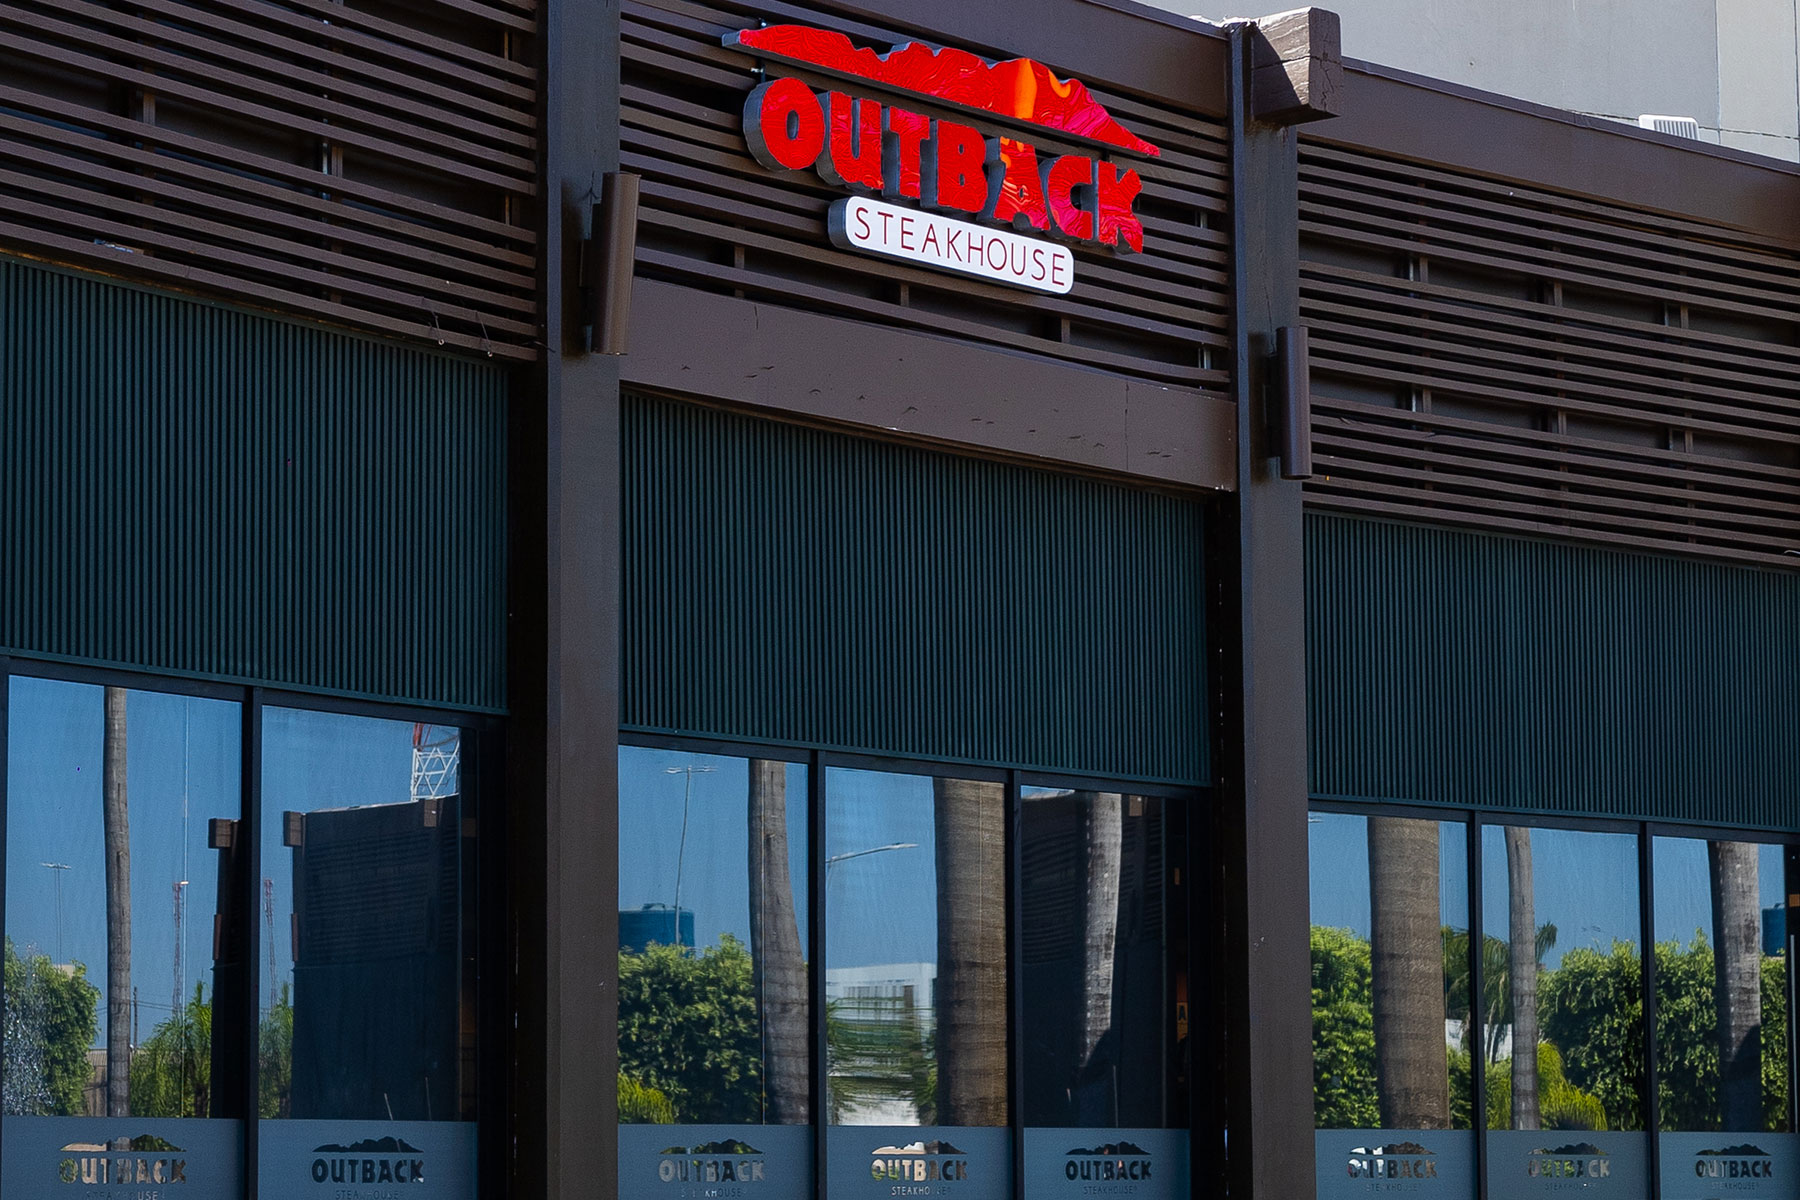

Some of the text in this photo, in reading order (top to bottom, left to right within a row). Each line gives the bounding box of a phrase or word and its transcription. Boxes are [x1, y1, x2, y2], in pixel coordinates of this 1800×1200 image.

[748, 77, 1143, 254] OUTBACK
[854, 206, 1066, 286] STEAKHOUSE
[59, 1157, 187, 1184] OUTBACK
[312, 1158, 424, 1183] OUTBACK
[659, 1159, 764, 1182] OUTBACK
[871, 1158, 968, 1181] OUTBACK
[1065, 1160, 1152, 1181] OUTBACK
[1347, 1158, 1438, 1179] OUTBACK
[1695, 1160, 1772, 1178] OUTBACK
